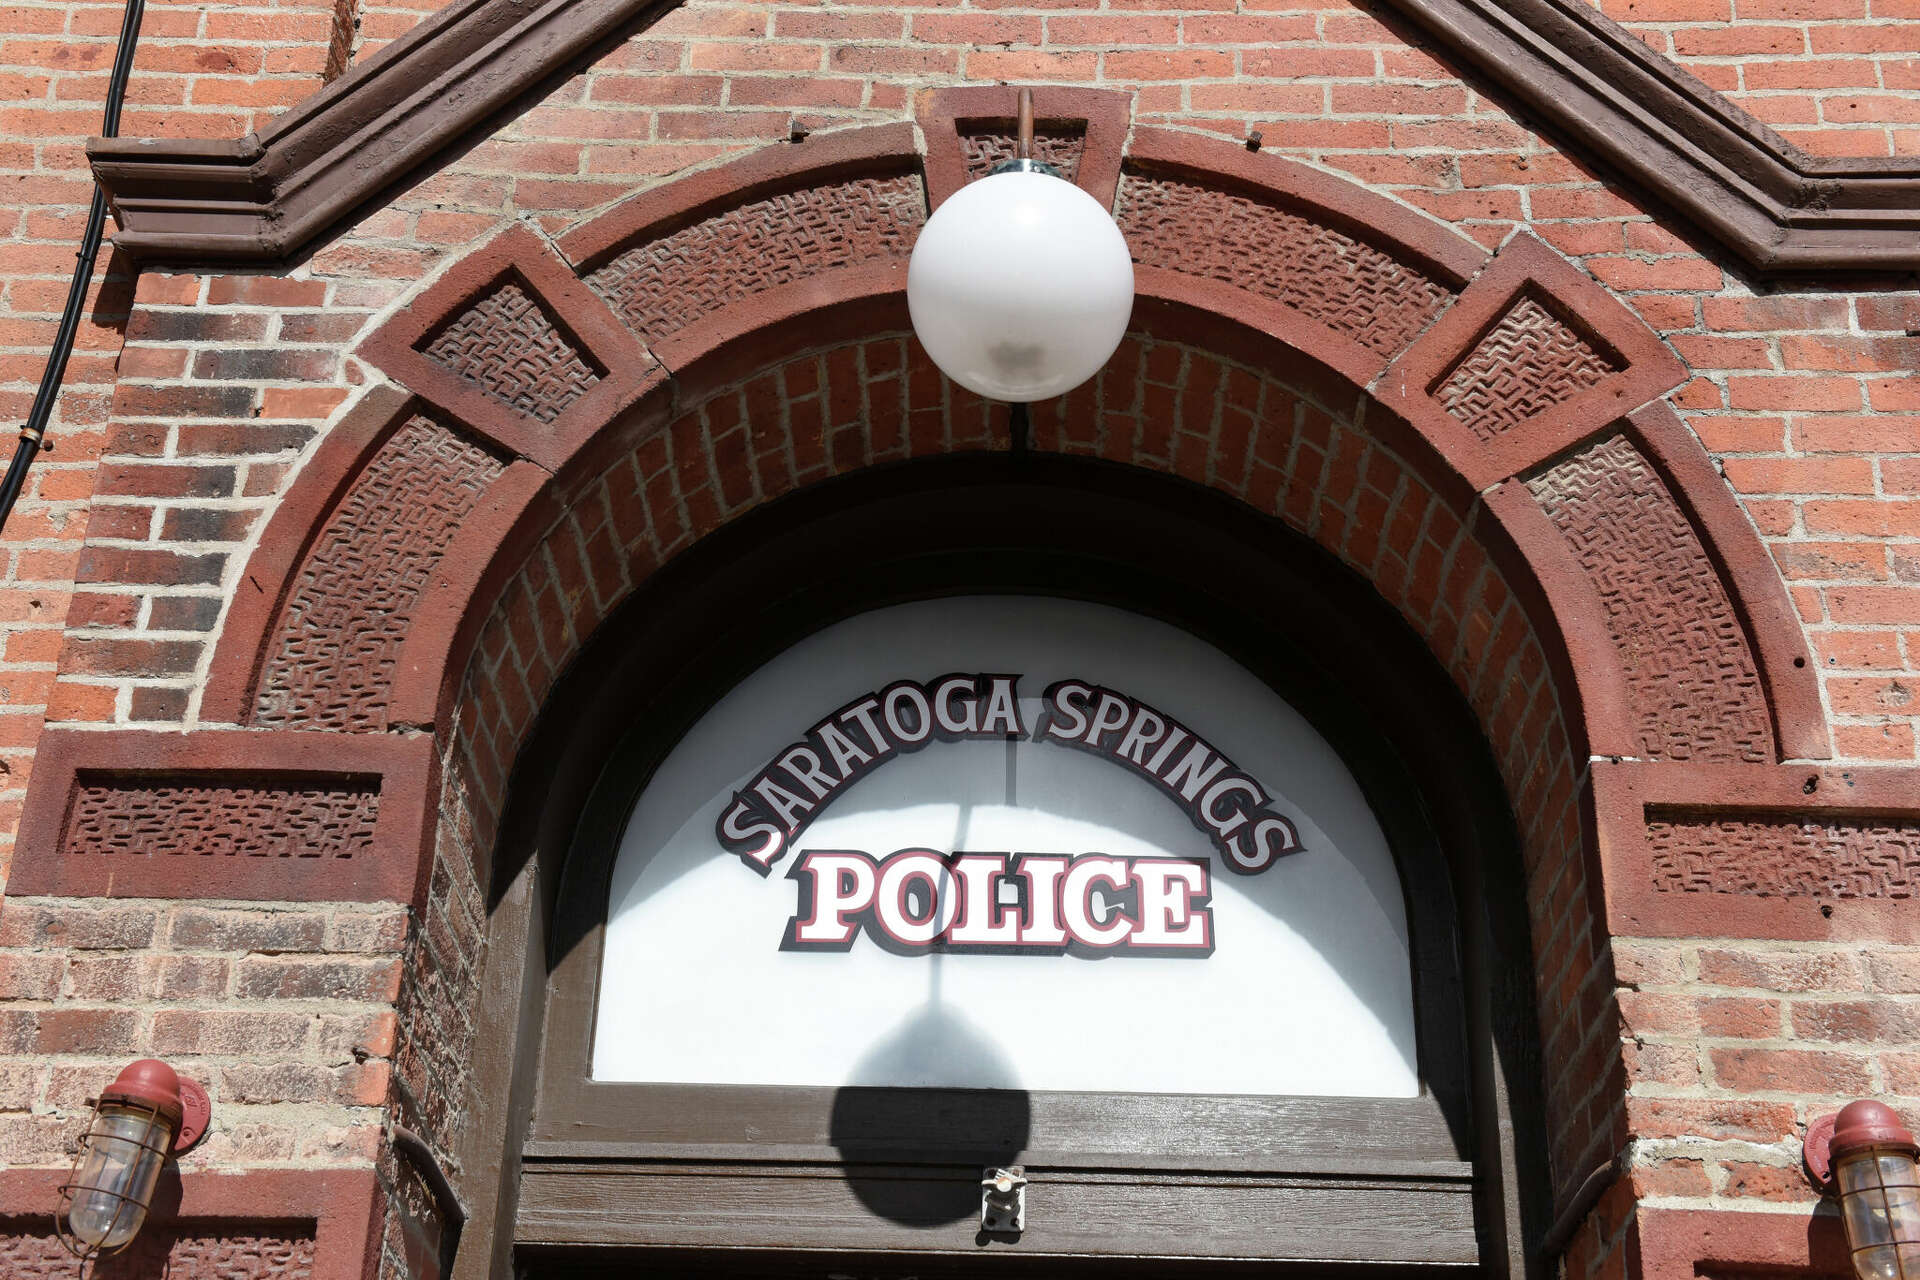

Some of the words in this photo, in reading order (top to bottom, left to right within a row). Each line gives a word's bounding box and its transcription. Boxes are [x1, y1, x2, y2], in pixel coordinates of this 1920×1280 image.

[717, 673, 1030, 878] SARATOGA
[1032, 679, 1308, 875] SPRINGS
[779, 848, 1215, 959] POLICE
